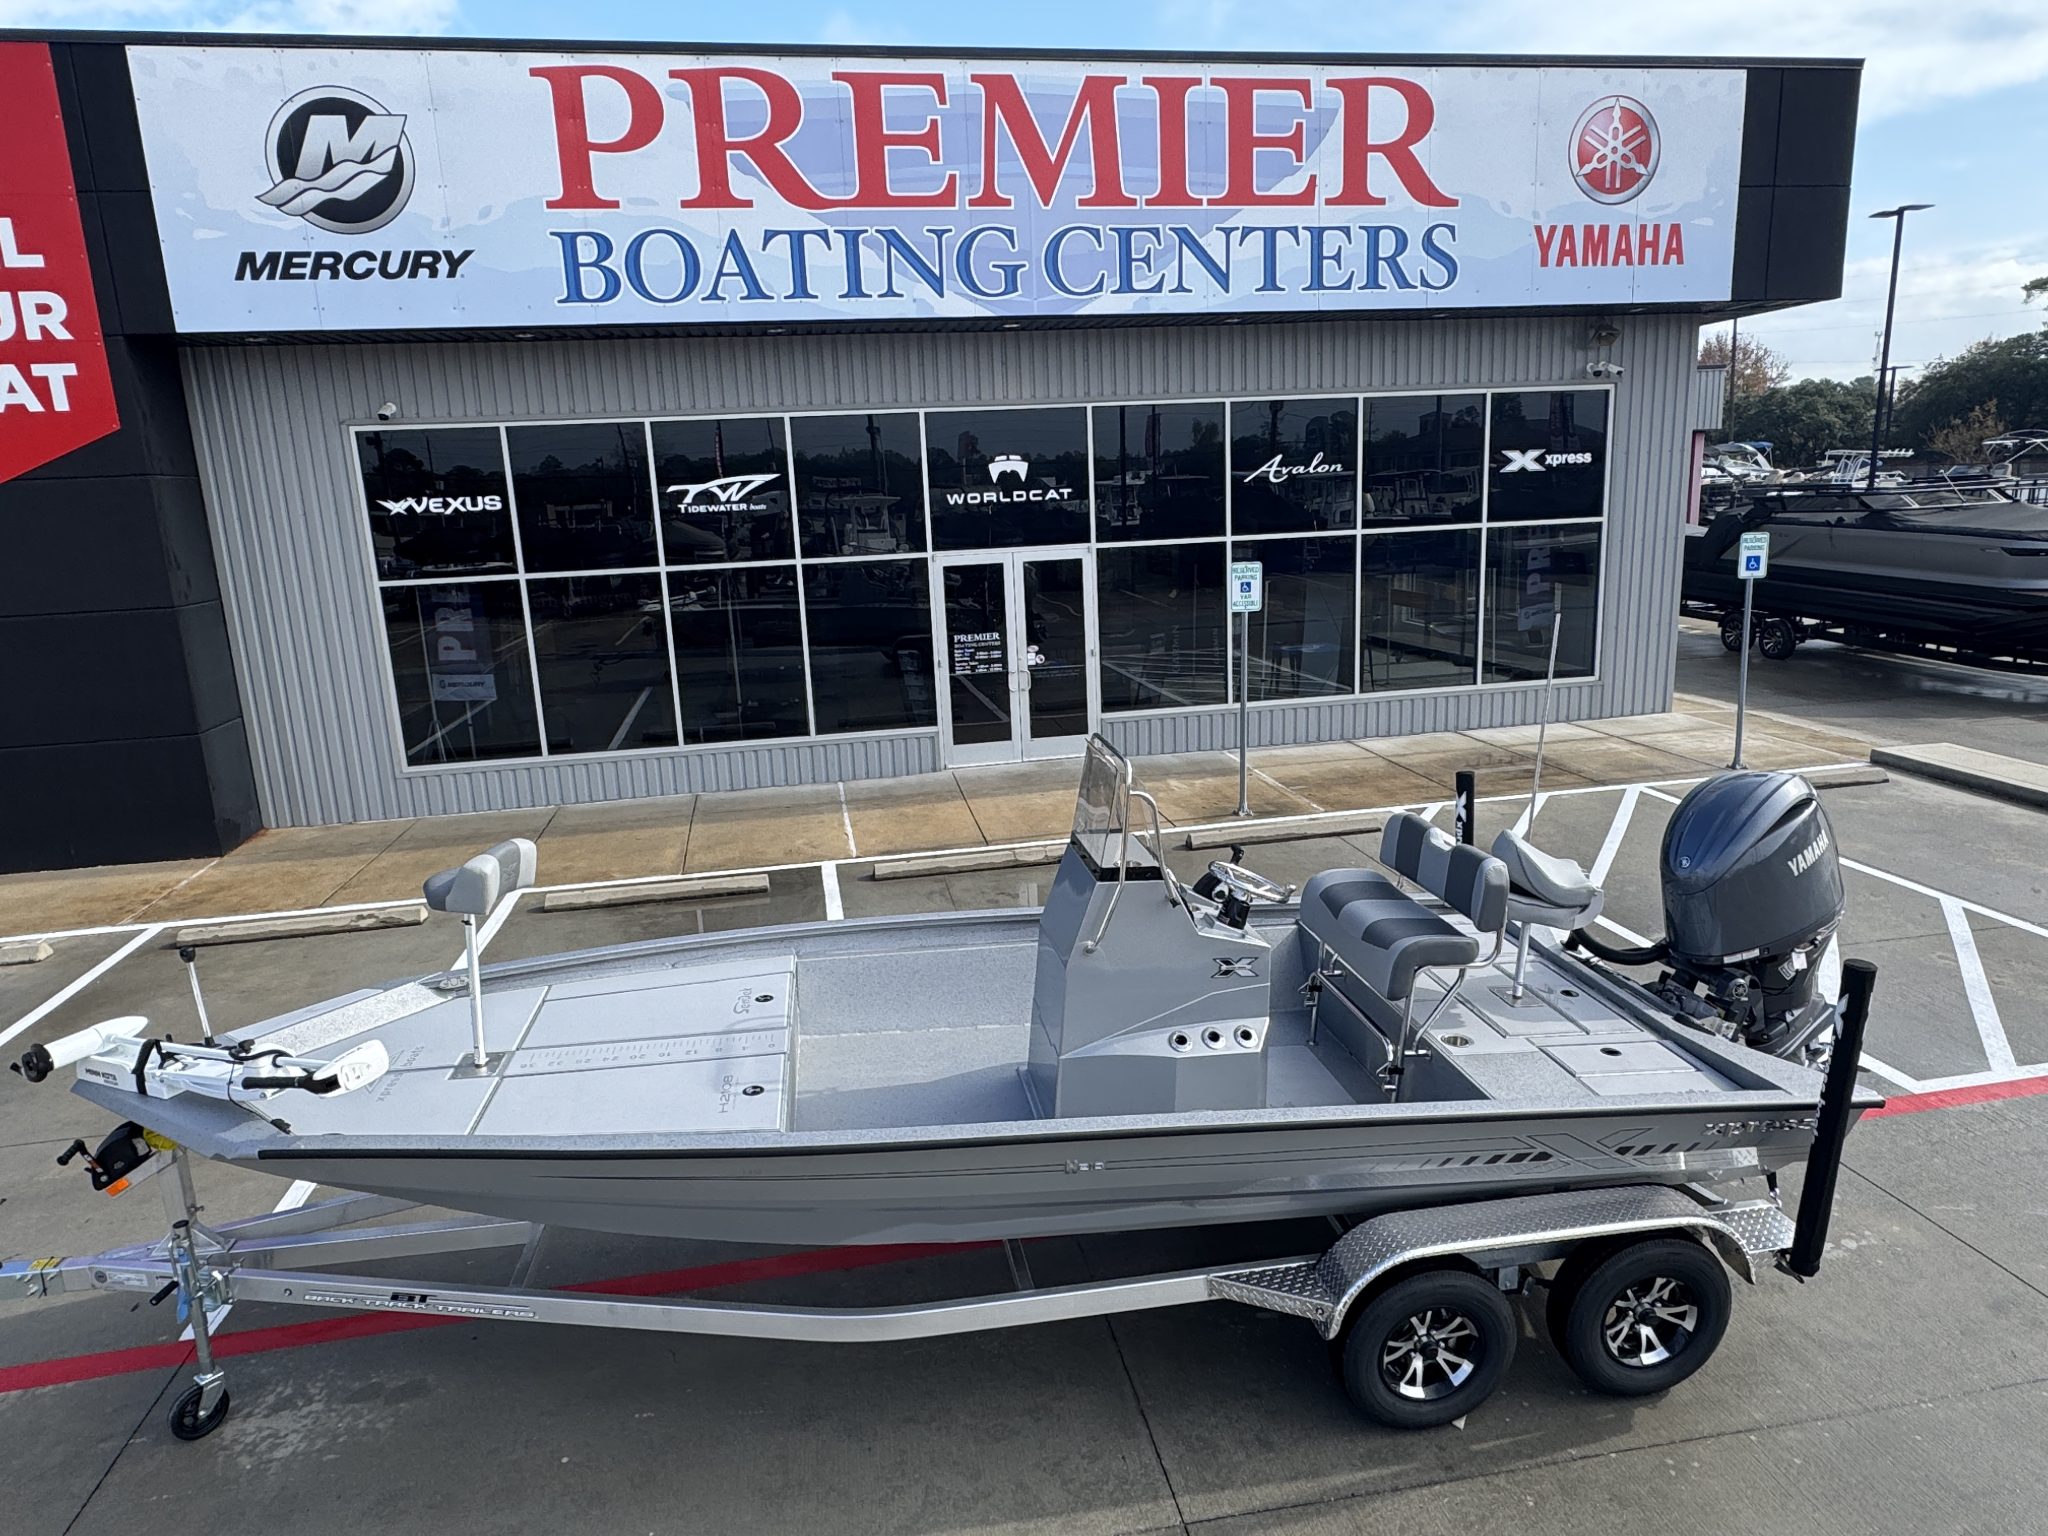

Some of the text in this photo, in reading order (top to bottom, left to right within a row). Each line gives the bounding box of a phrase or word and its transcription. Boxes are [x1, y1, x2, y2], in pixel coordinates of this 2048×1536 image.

[529, 65, 1459, 210] PREMIER
[1535, 222, 1685, 268] YAMAHA
[234, 249, 474, 281] MERCURY
[549, 223, 1459, 304] BOATING CENTERS
[1243, 451, 1343, 483] Avalon
[1544, 451, 1592, 466] xpress
[406, 495, 502, 514] VEXUS
[677, 503, 748, 513] TIDEWATER
[946, 488, 1073, 506] WORLDCAT
[953, 632, 1000, 643] PREMIER
[1787, 828, 1829, 877] YAMAHA
[304, 1294, 354, 1304] BACK
[364, 1299, 428, 1310] TRACK
